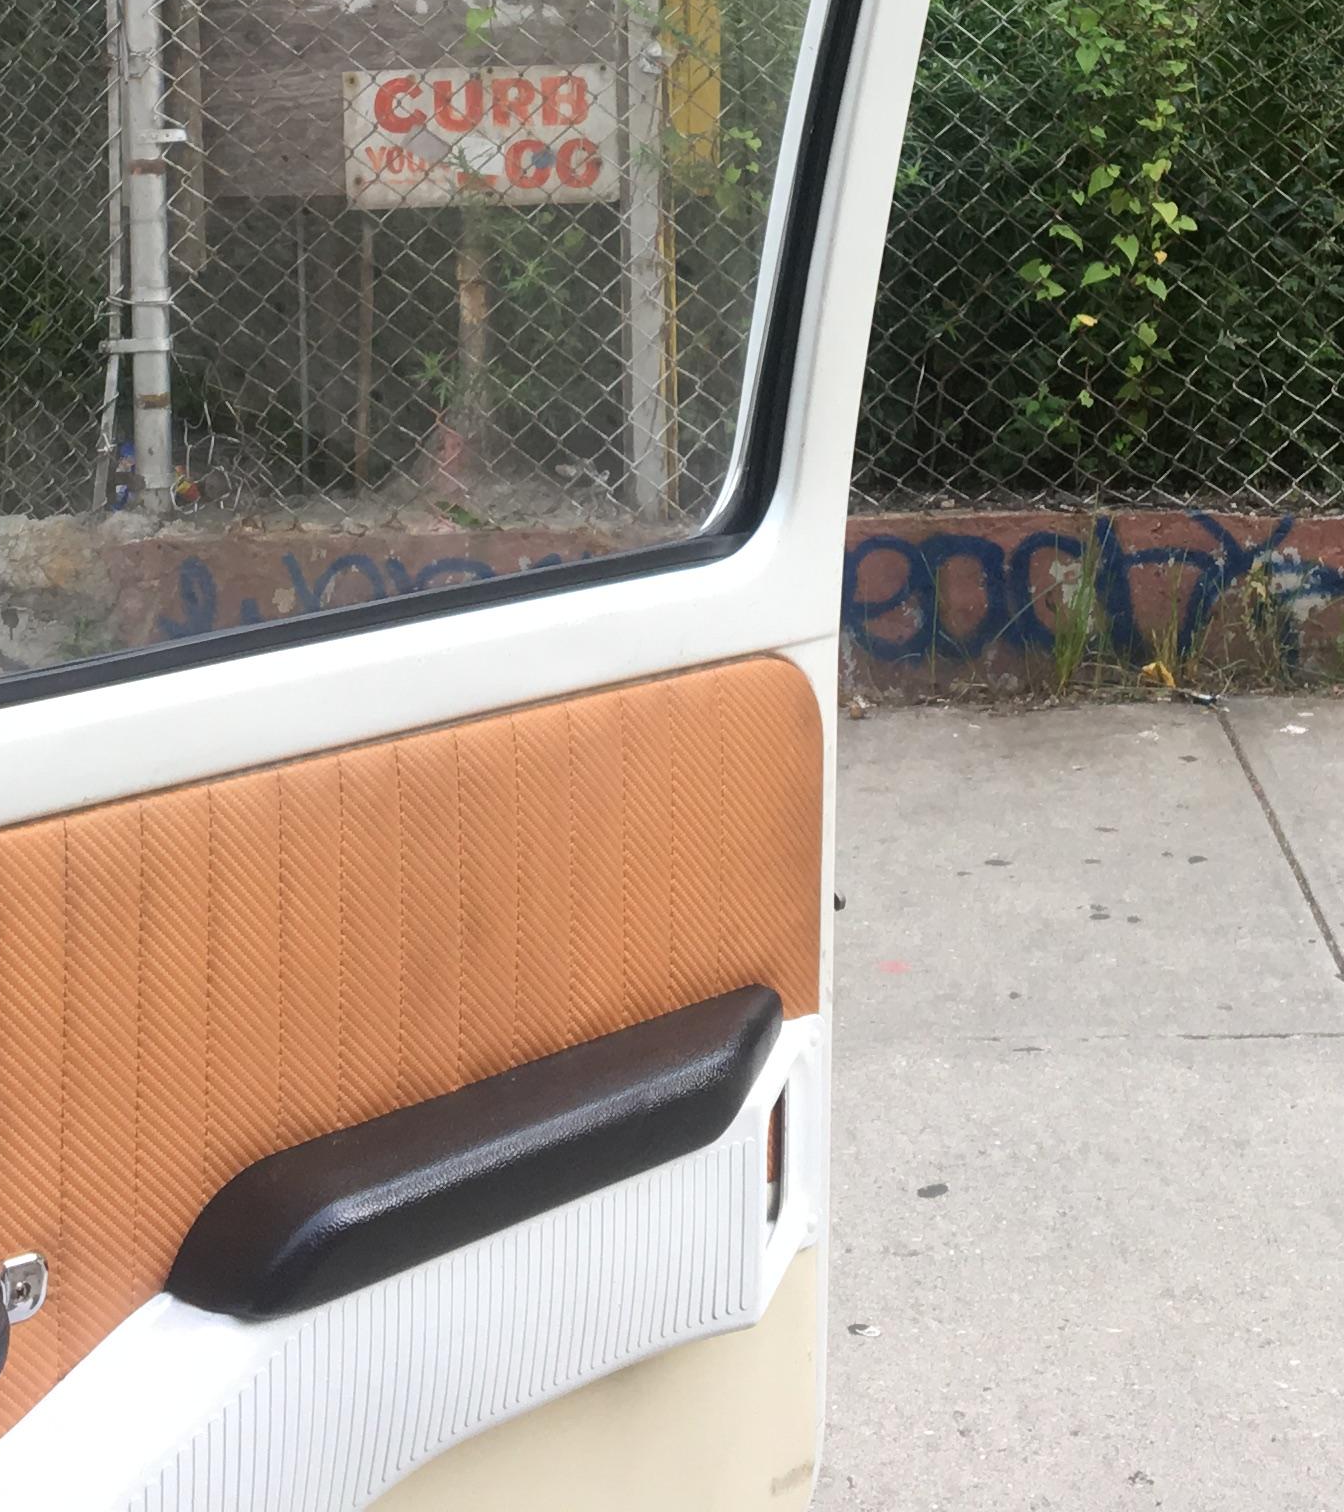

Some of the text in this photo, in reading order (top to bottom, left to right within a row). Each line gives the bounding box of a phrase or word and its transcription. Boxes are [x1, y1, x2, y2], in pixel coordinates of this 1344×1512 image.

[374, 76, 589, 134] CURB
[365, 138, 603, 190] YOU OG
